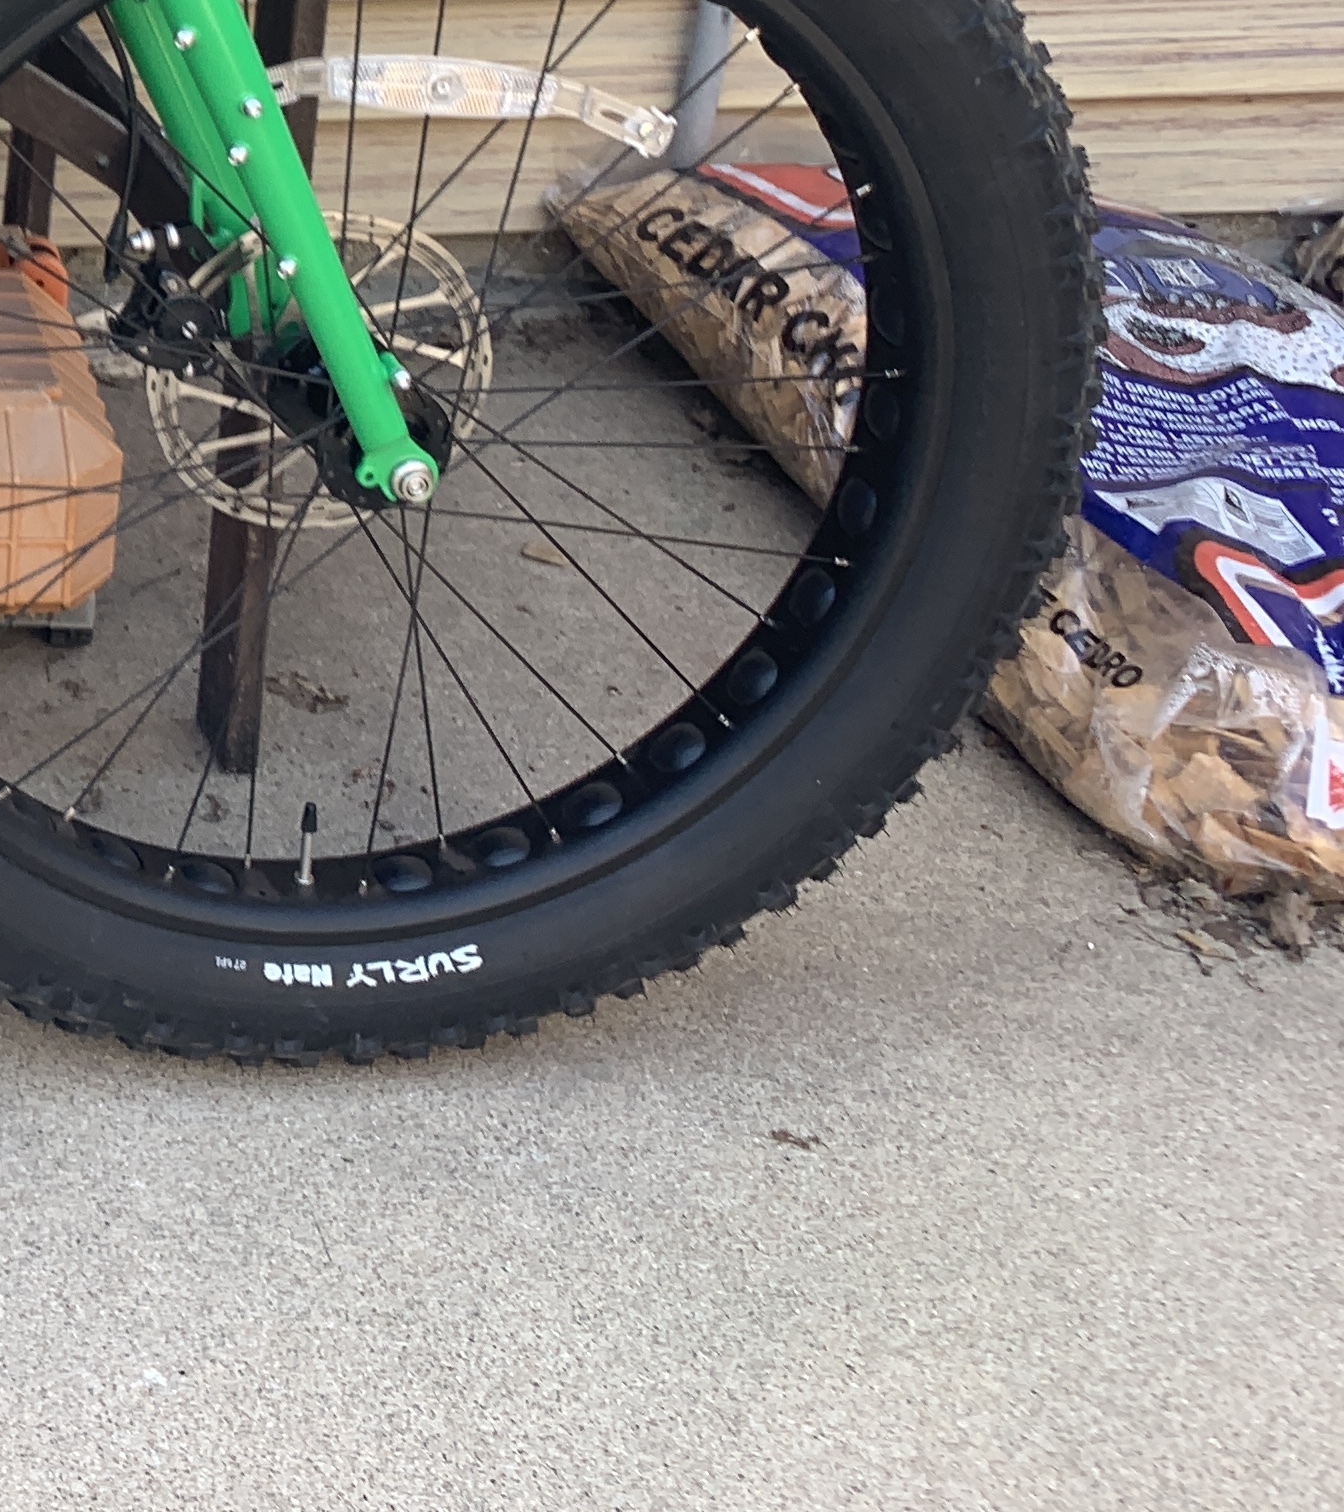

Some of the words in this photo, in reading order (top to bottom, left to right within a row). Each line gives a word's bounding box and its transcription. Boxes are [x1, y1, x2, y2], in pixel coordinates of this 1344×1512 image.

[637, 206, 790, 323] CEDAR
[1124, 380, 1196, 405] GROUND
[1116, 422, 1169, 441] LONG
[1049, 608, 1144, 688] CEDRO
[263, 961, 334, 988] Nate
[345, 943, 484, 988] SURLY
